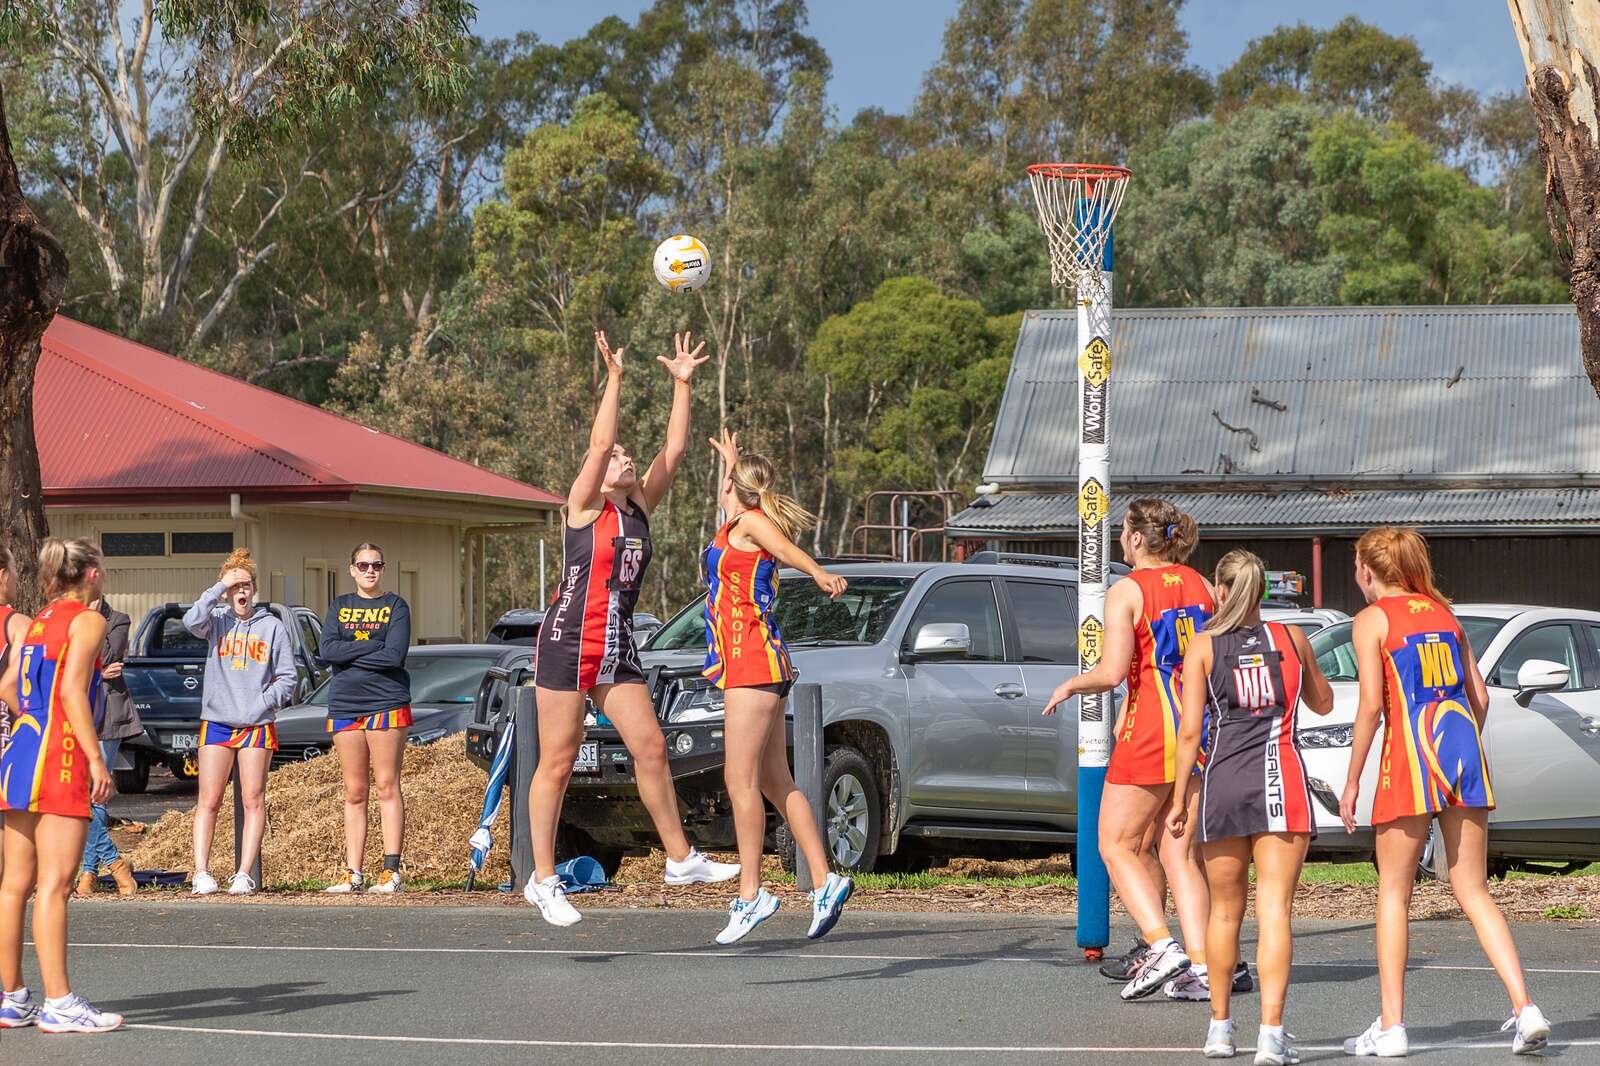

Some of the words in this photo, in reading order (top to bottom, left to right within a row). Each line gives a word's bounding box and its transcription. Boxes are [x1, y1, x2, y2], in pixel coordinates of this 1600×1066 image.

[620, 549, 642, 582] GS
[338, 606, 391, 624] SFNC
[550, 565, 580, 641] BENALLA
[730, 571, 743, 659] SEYMOUR
[601, 613, 617, 675] SAINTS
[1417, 642, 1458, 688] WD
[1233, 666, 1276, 708] WA
[60, 720, 75, 784] MOUR
[576, 745, 596, 762] SE
[1268, 743, 1283, 818] SAINTS
